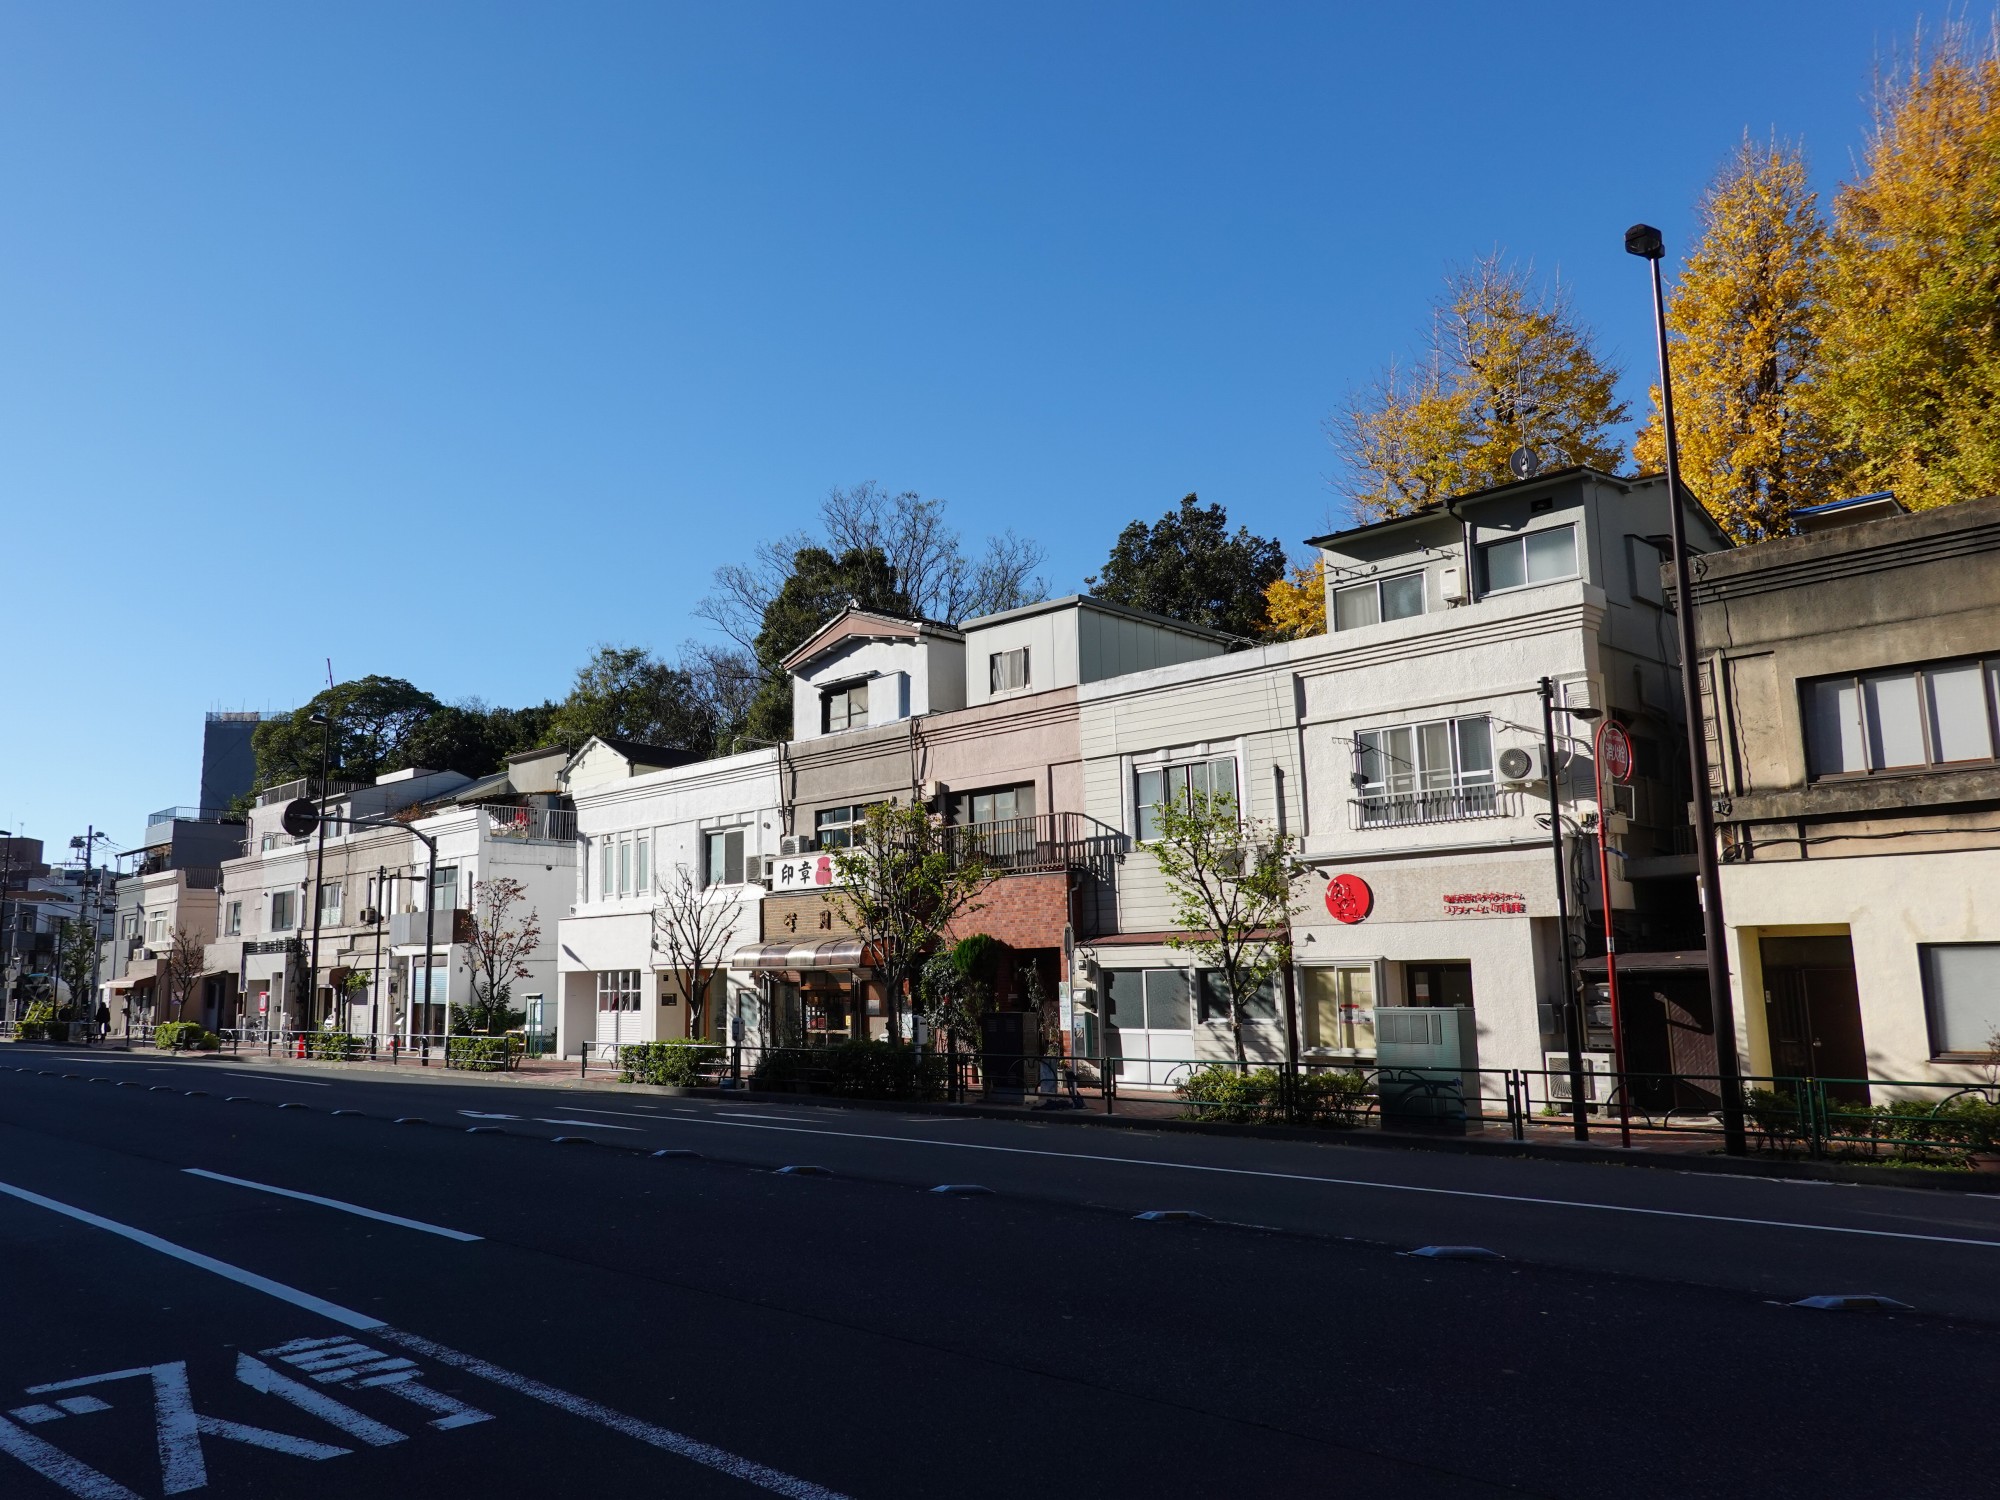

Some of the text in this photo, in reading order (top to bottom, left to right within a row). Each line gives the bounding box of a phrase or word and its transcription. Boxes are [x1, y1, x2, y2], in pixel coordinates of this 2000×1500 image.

[1605, 742, 1626, 763] 消火栓
[781, 860, 812, 885] 印章
